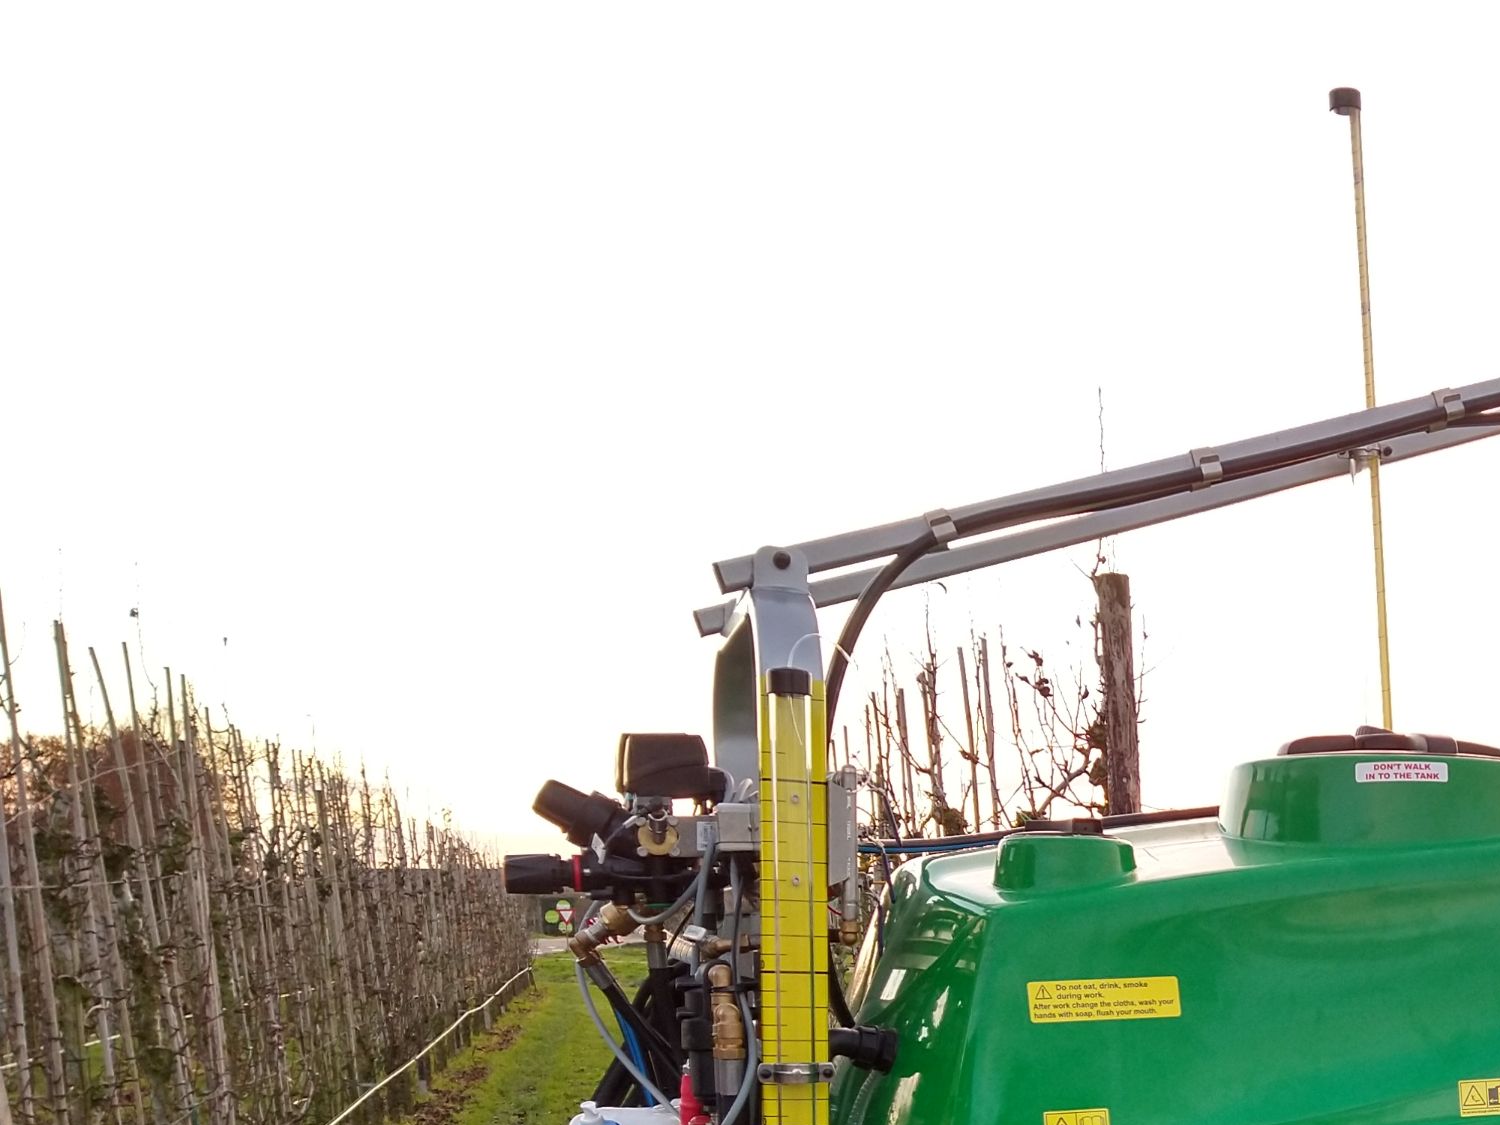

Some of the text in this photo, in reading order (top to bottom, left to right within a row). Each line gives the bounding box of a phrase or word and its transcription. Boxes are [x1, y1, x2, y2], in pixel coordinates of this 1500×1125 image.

[1415, 772, 1440, 780] TANK
[1084, 983, 1098, 991] eat,
[1057, 993, 1082, 1001] during
[1053, 1002, 1071, 1010] work
[1072, 1002, 1098, 1010] change
[1158, 999, 1174, 1007] your
[1116, 1009, 1131, 1017] your
